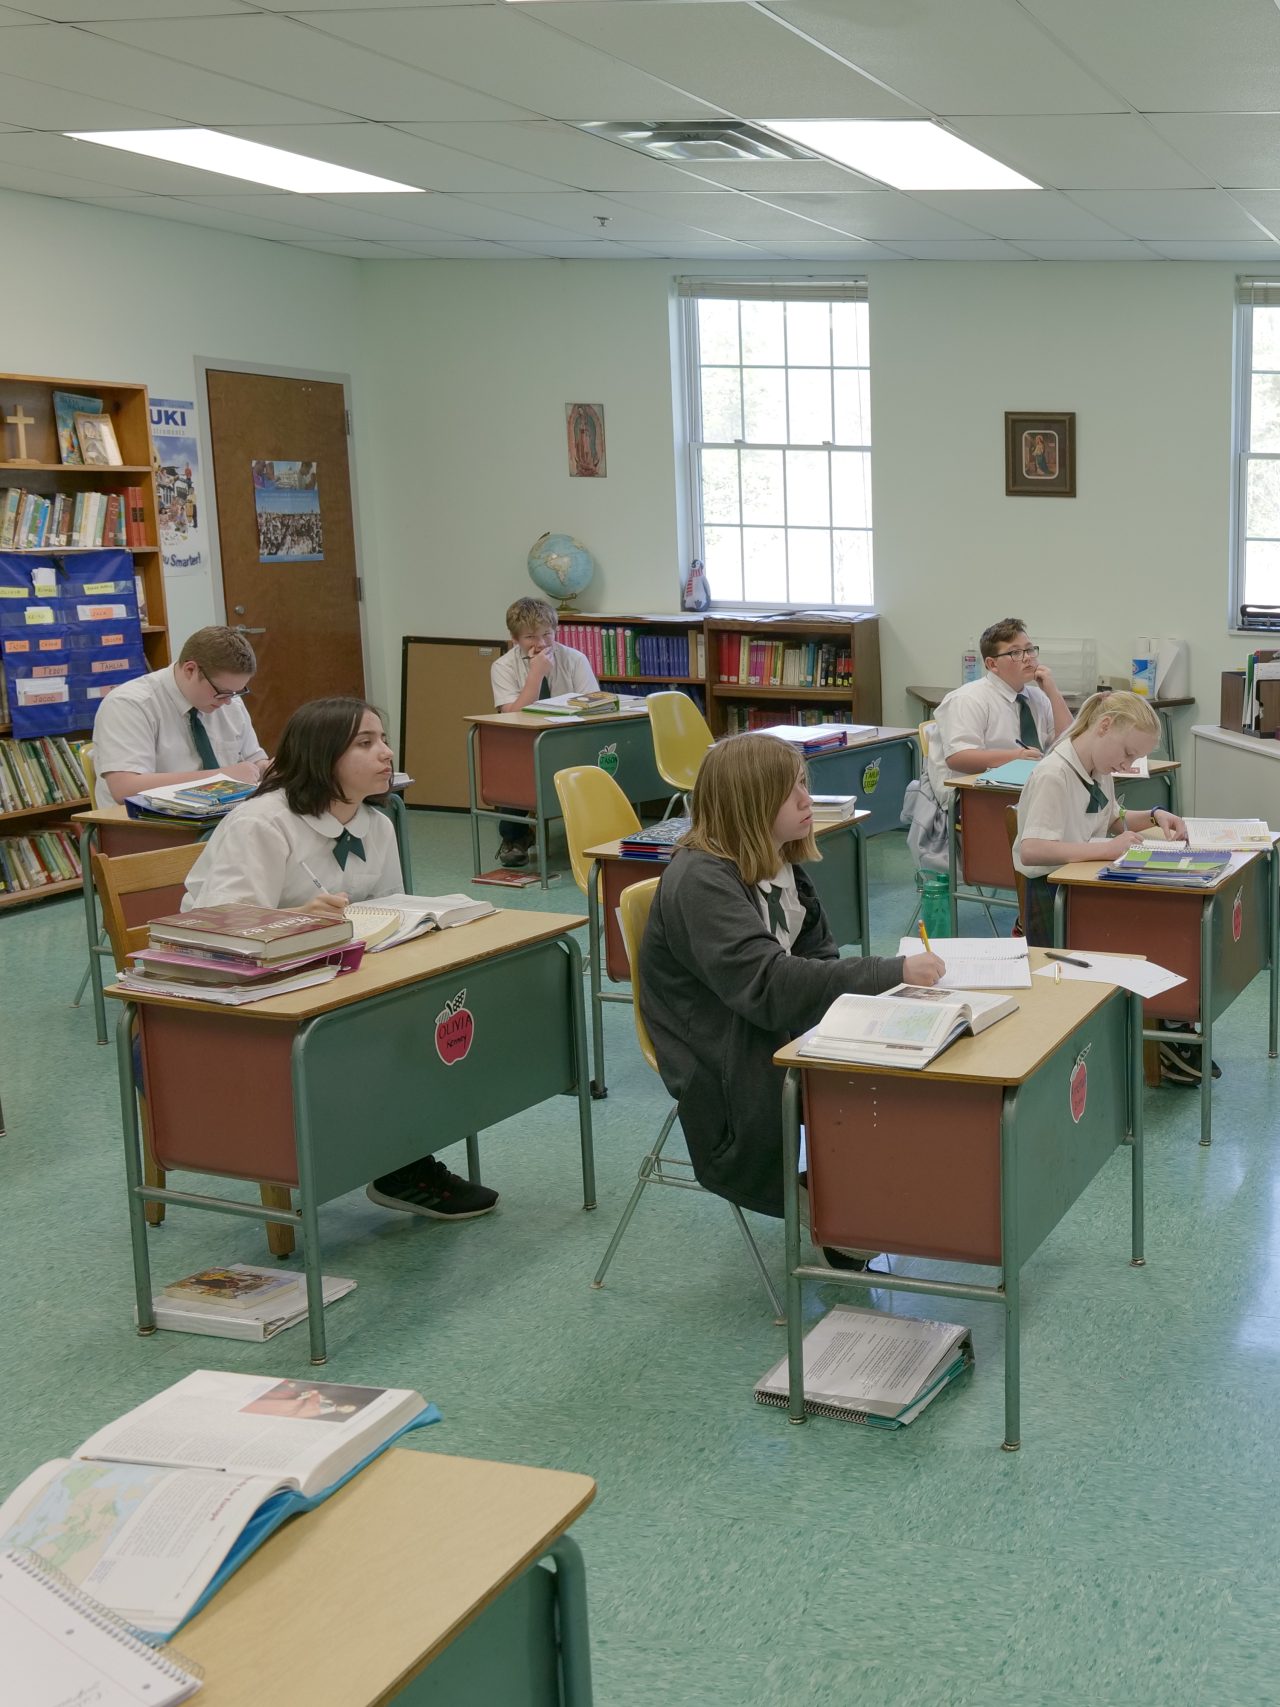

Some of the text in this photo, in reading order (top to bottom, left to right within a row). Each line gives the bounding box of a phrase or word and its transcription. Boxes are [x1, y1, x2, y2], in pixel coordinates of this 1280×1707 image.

[150, 408, 187, 428] UKI
[169, 552, 202, 568] Smarter!
[439, 1014, 472, 1040] OLIVIA
